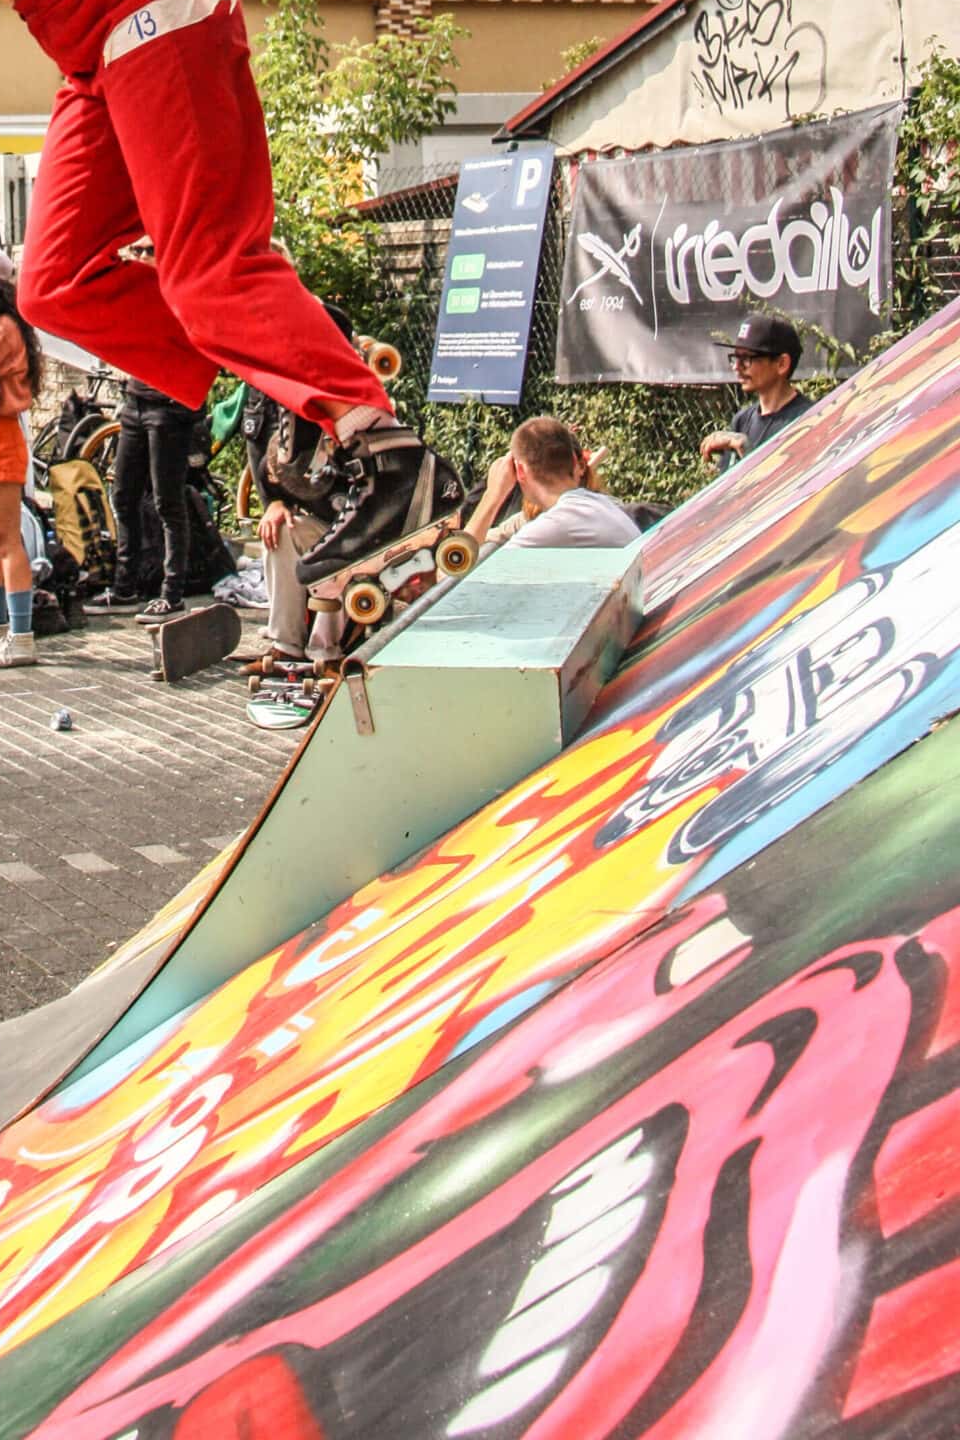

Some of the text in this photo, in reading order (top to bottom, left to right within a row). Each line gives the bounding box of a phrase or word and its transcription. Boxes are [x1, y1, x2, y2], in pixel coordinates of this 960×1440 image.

[127, 9, 157, 40] 13
[516, 159, 543, 207] P
[599, 295, 625, 311] 1994
